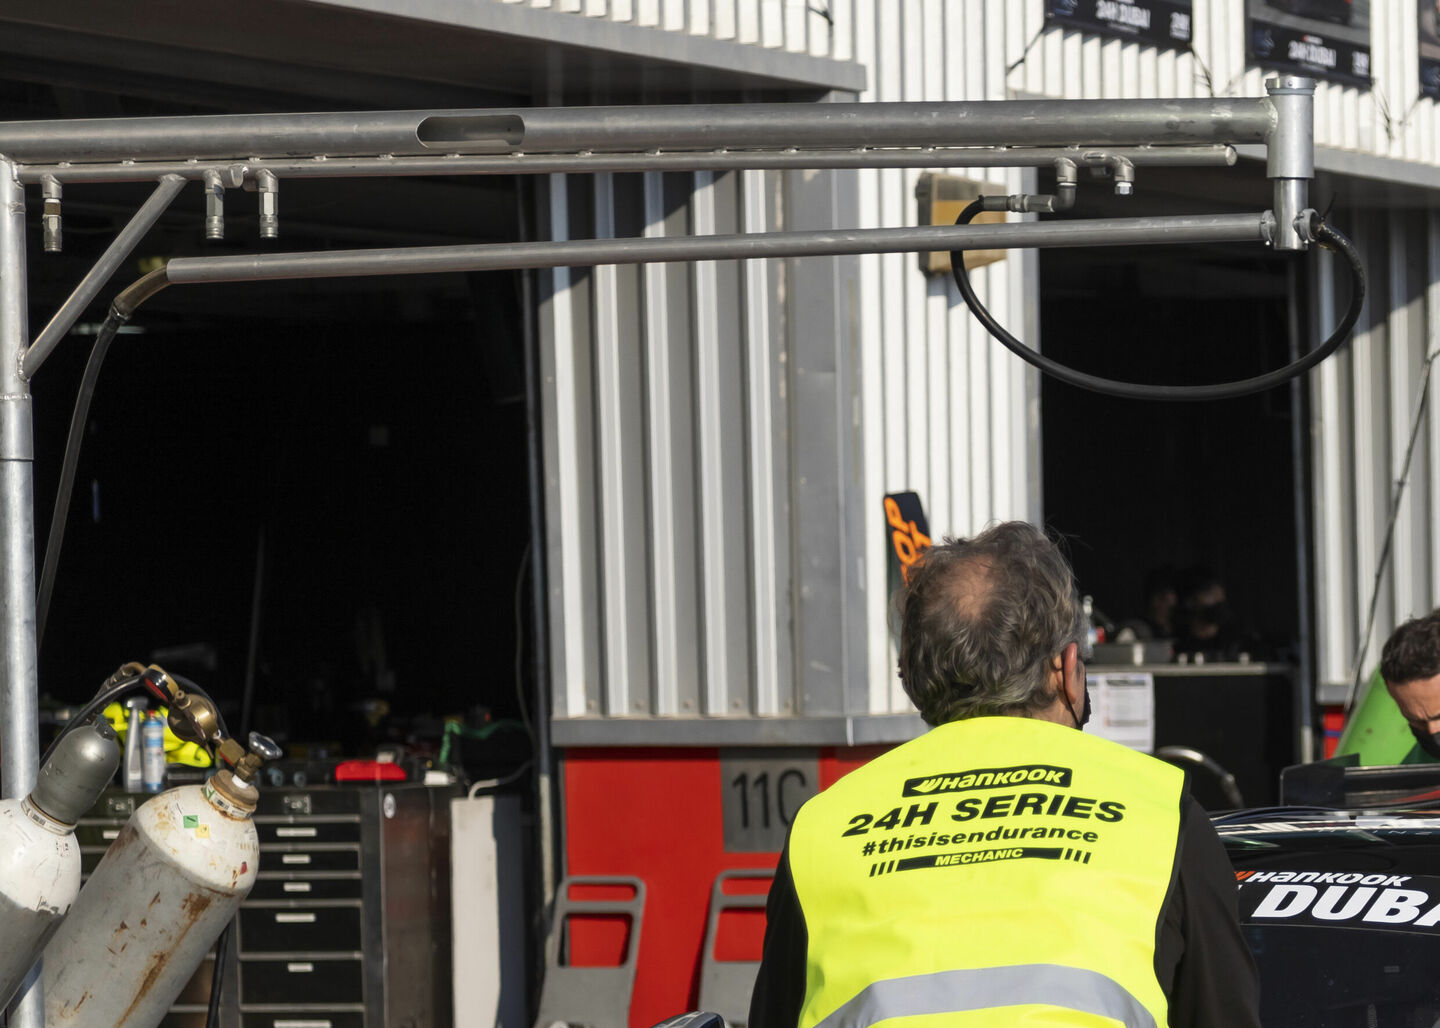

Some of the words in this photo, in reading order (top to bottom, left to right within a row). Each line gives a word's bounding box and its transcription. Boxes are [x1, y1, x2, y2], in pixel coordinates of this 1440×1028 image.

[842, 801, 939, 837] 24H
[951, 793, 1126, 823] SERIES
[862, 825, 1099, 857] #thisisendurance
[934, 847, 1024, 867] MECHANIC
